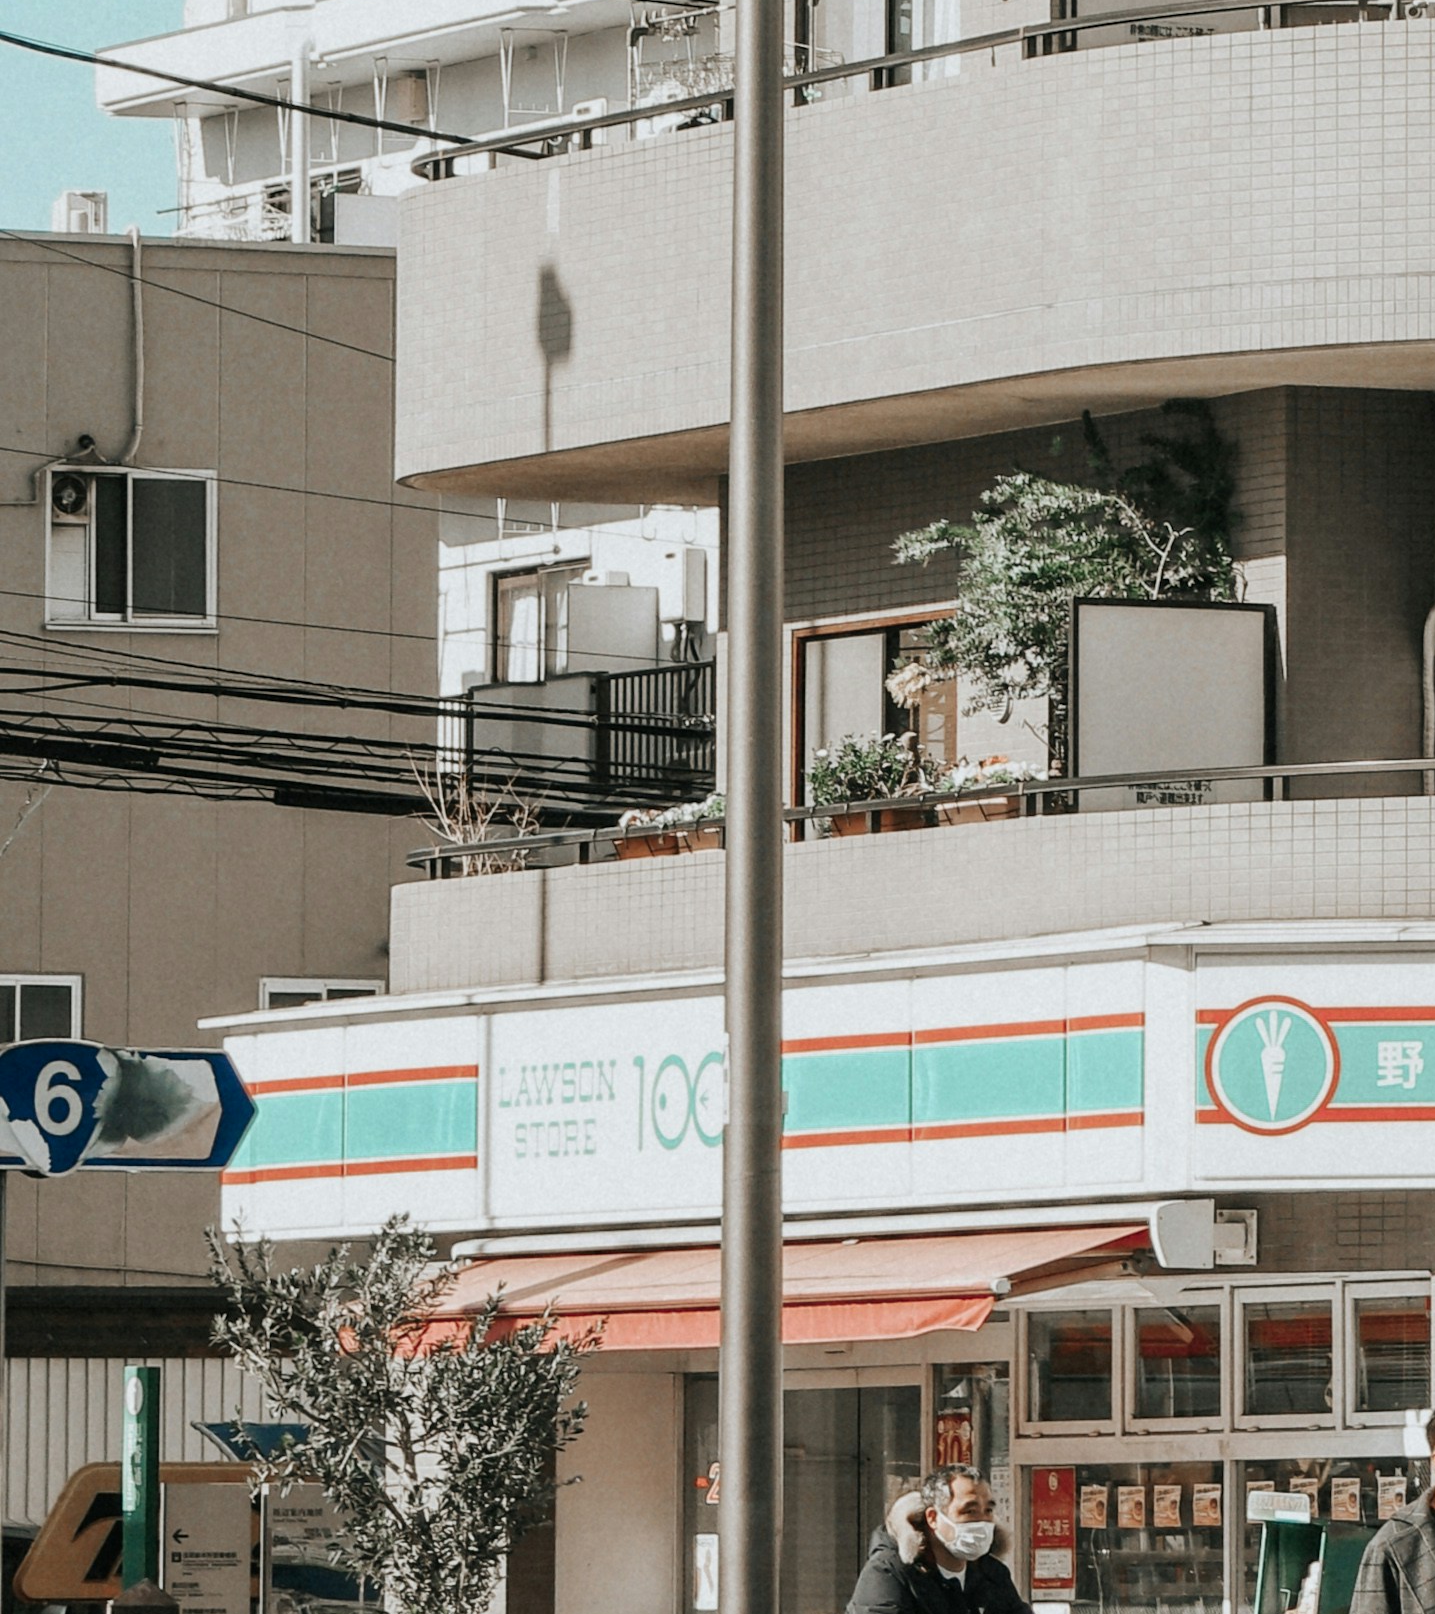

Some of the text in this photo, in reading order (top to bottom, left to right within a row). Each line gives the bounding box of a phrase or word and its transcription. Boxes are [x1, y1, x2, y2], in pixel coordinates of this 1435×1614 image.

[34, 1059, 83, 1137] 6
[499, 1058, 617, 1109] LAWSON
[514, 1118, 597, 1159] STORE
